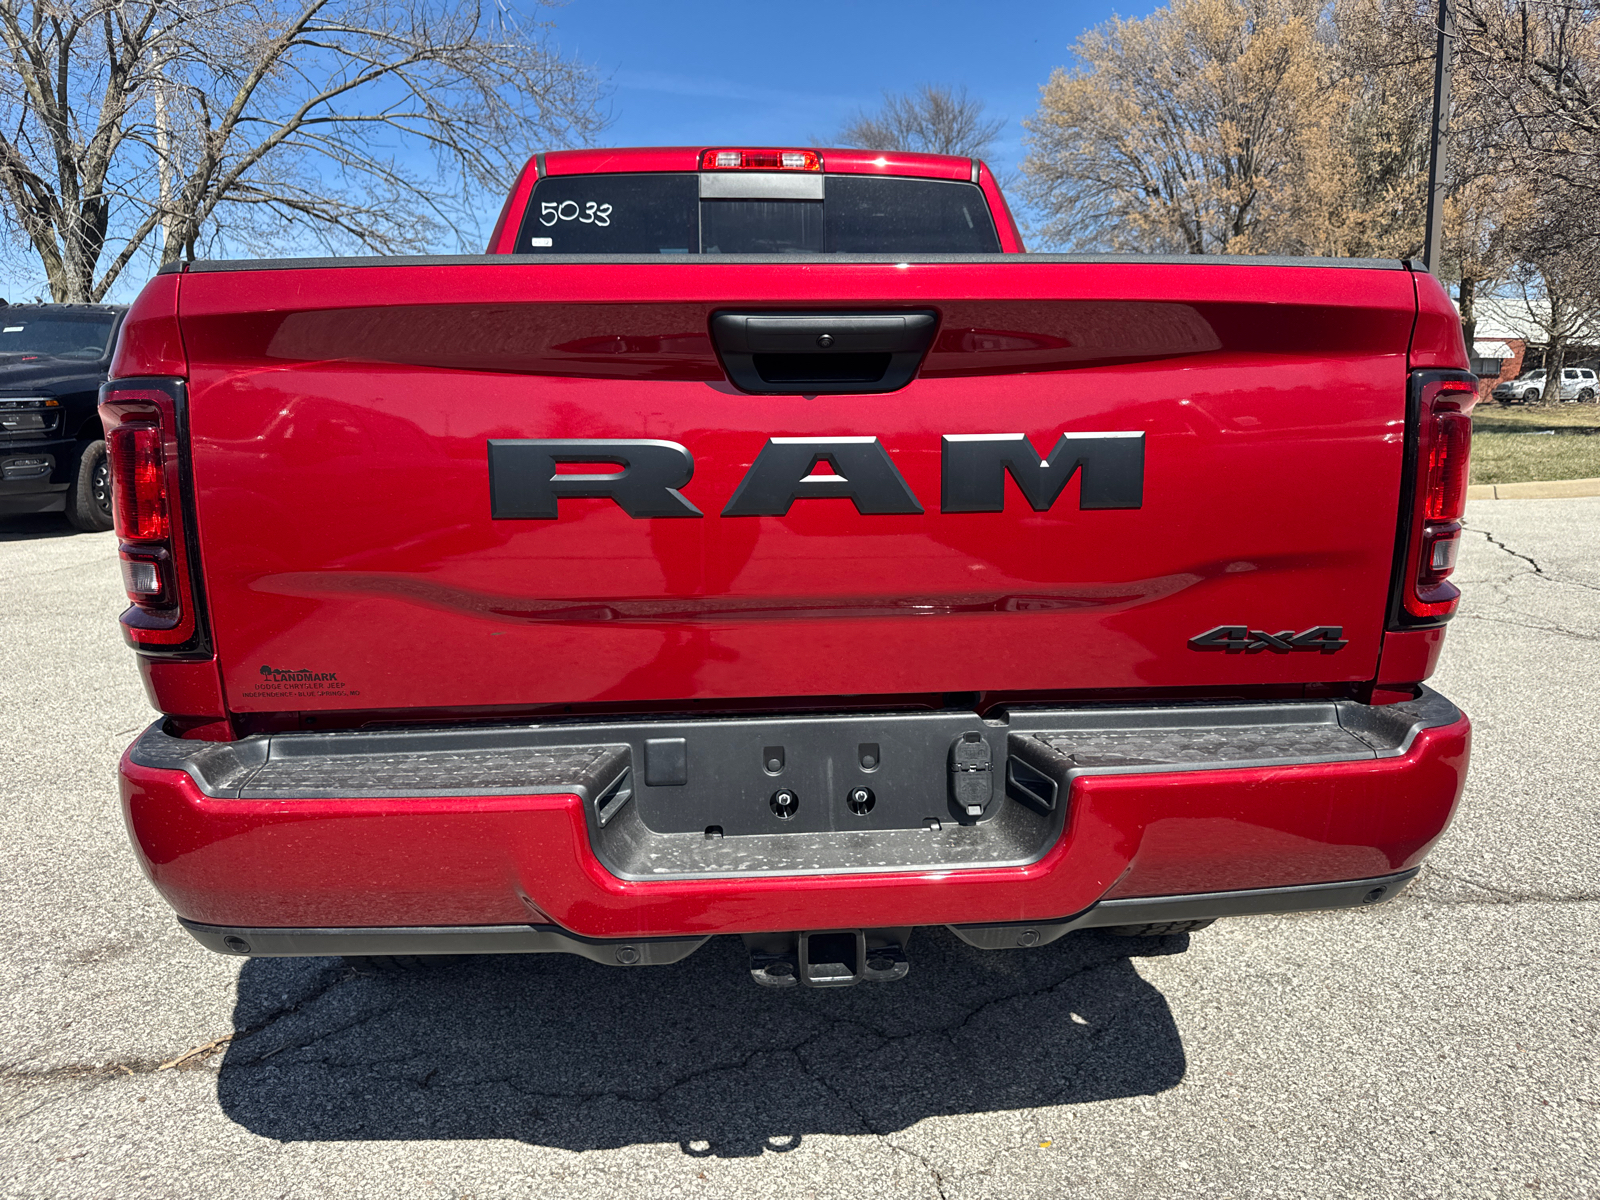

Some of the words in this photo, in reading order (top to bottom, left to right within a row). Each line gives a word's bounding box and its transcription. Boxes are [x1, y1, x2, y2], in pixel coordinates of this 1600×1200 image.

[539, 199, 612, 227] 5033
[487, 430, 1146, 521] RAM
[1189, 624, 1349, 651] 4x4
[273, 673, 337, 682] LANDMARK
[283, 682, 324, 690] CHRYSLER
